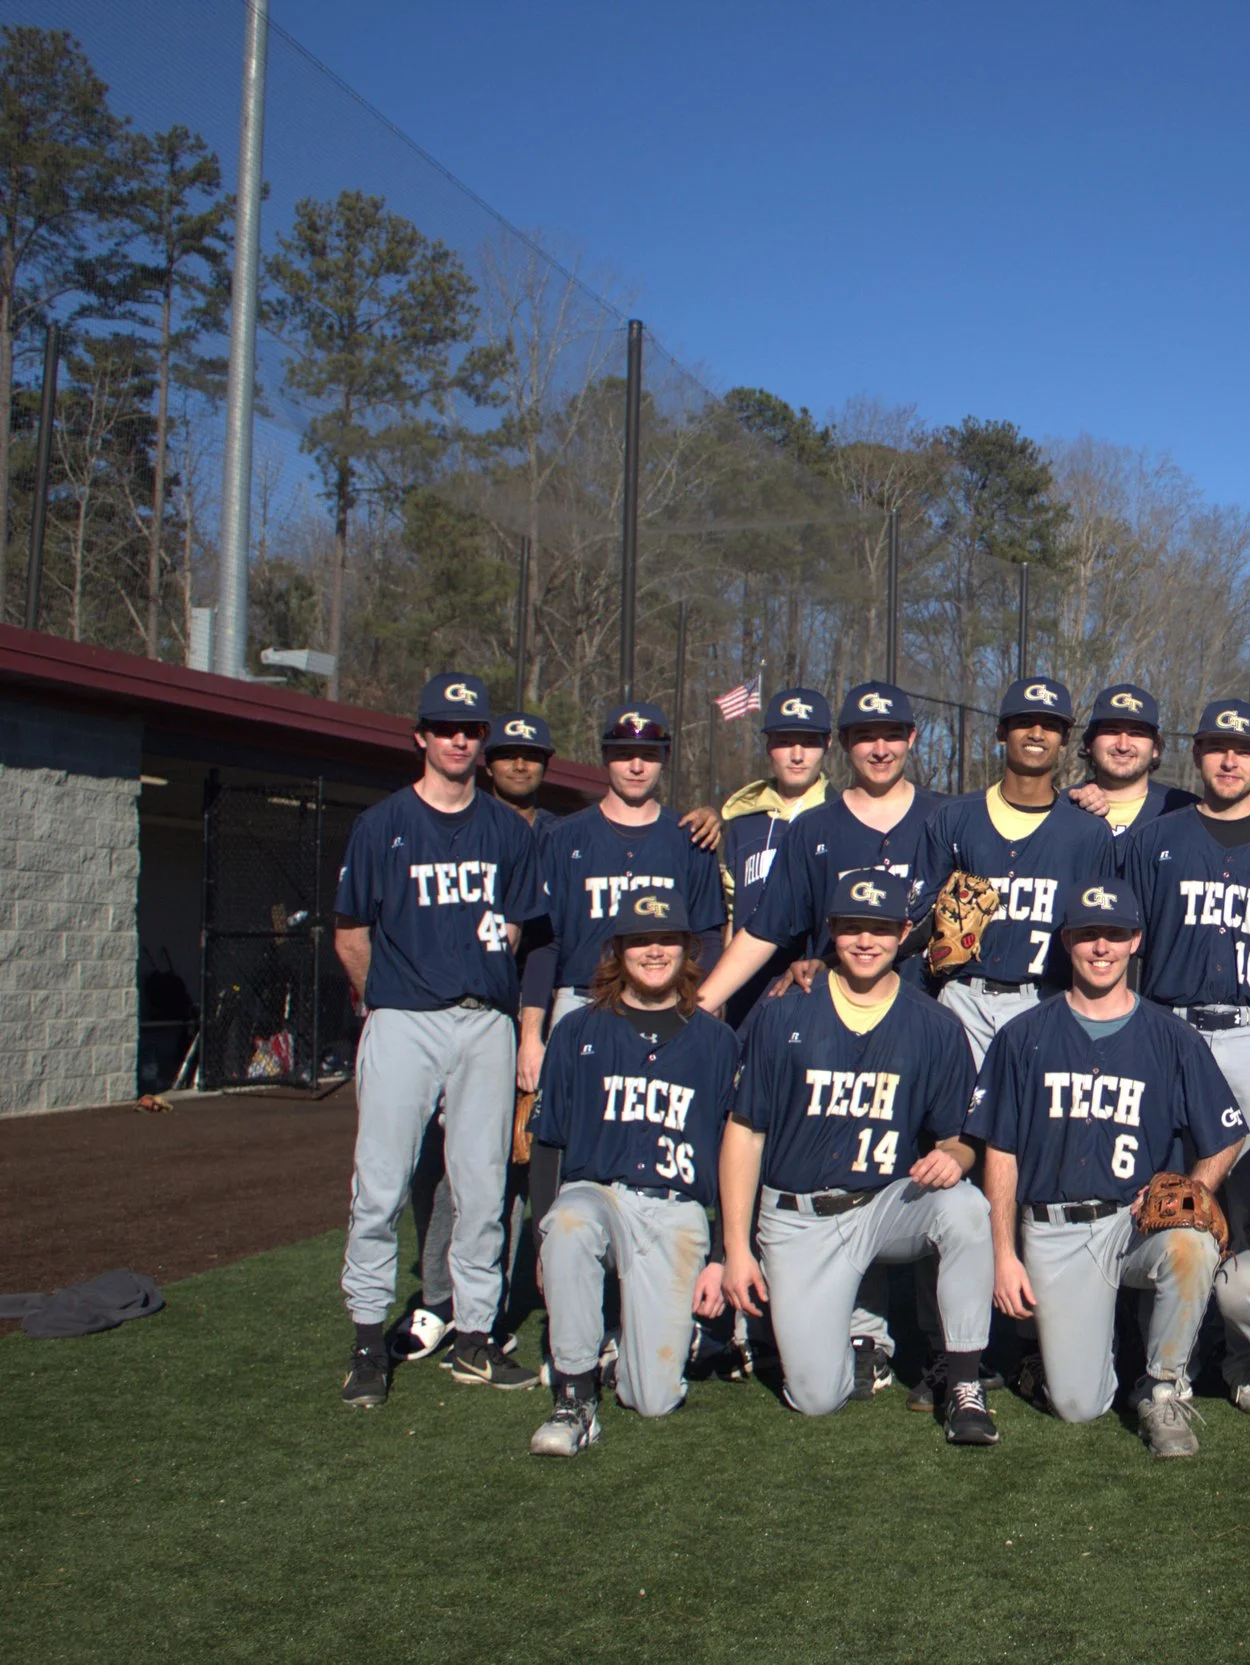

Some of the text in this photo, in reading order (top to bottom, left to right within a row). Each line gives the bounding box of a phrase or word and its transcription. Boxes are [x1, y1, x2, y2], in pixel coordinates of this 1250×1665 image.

[1028, 930, 1051, 974] 7
[604, 1076, 695, 1131] TECH
[806, 1070, 900, 1120] TECH
[1045, 1073, 1145, 1126] TECH
[656, 1136, 694, 1183] 36
[852, 1128, 899, 1174] 14
[1112, 1134, 1138, 1179] 6
